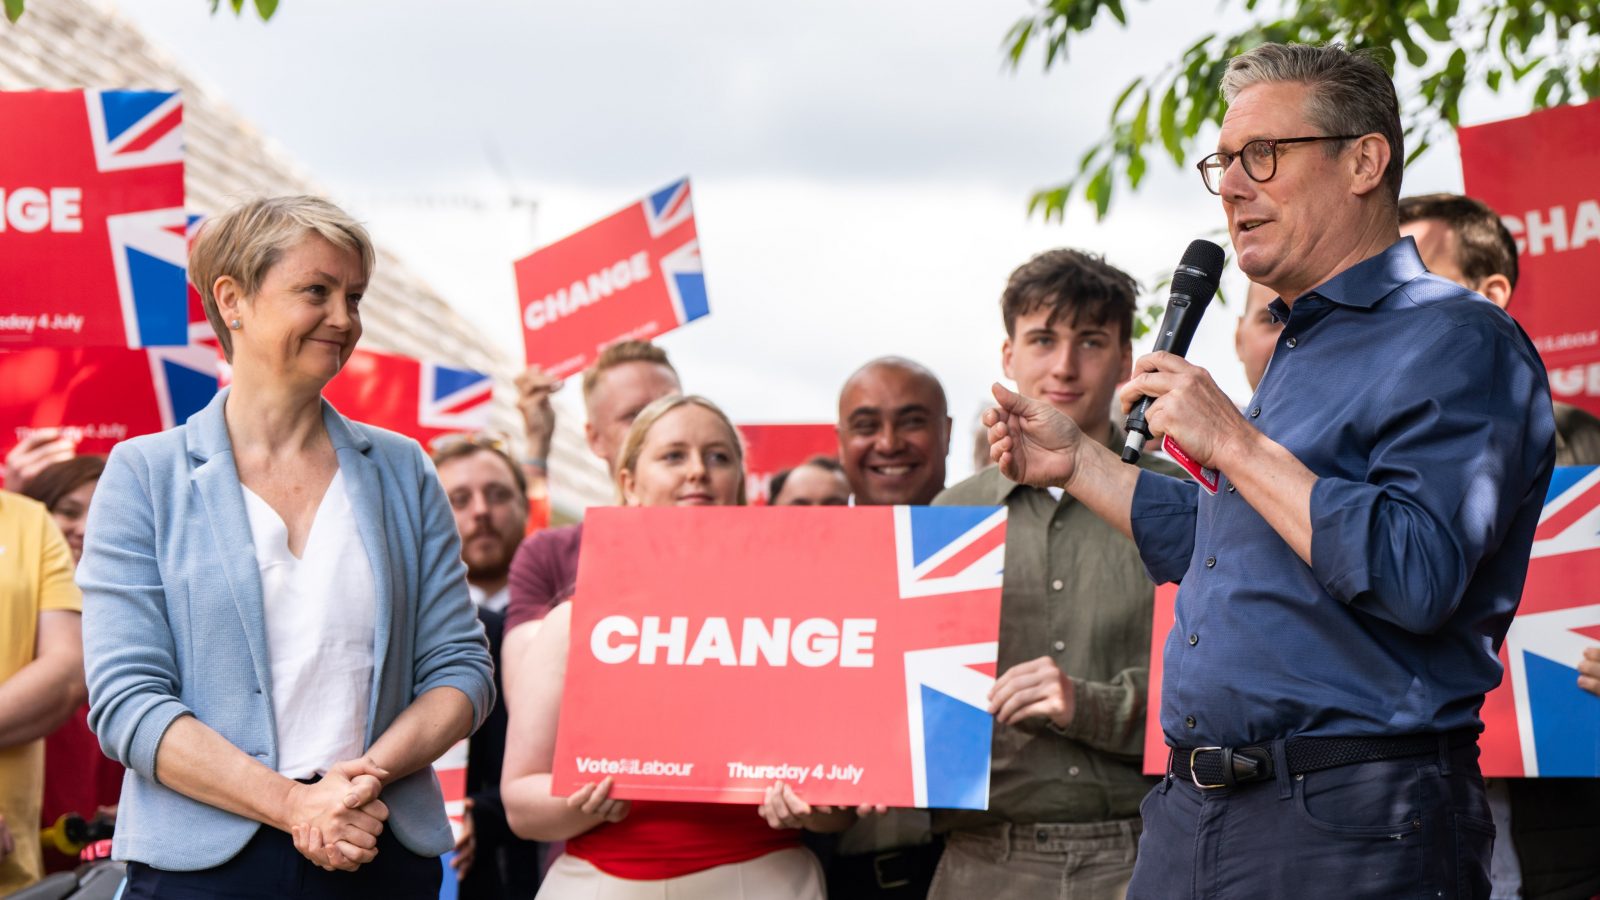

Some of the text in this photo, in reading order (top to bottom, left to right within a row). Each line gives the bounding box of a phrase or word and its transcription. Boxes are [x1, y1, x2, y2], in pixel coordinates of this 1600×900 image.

[0, 186, 83, 233] GE
[524, 250, 651, 330] CHANGE
[38, 314, 49, 330] 4
[50, 314, 85, 334] July
[590, 615, 877, 668] CHANGE
[576, 757, 694, 776] Vote Labour
[727, 762, 864, 784] Thursday 4 July
